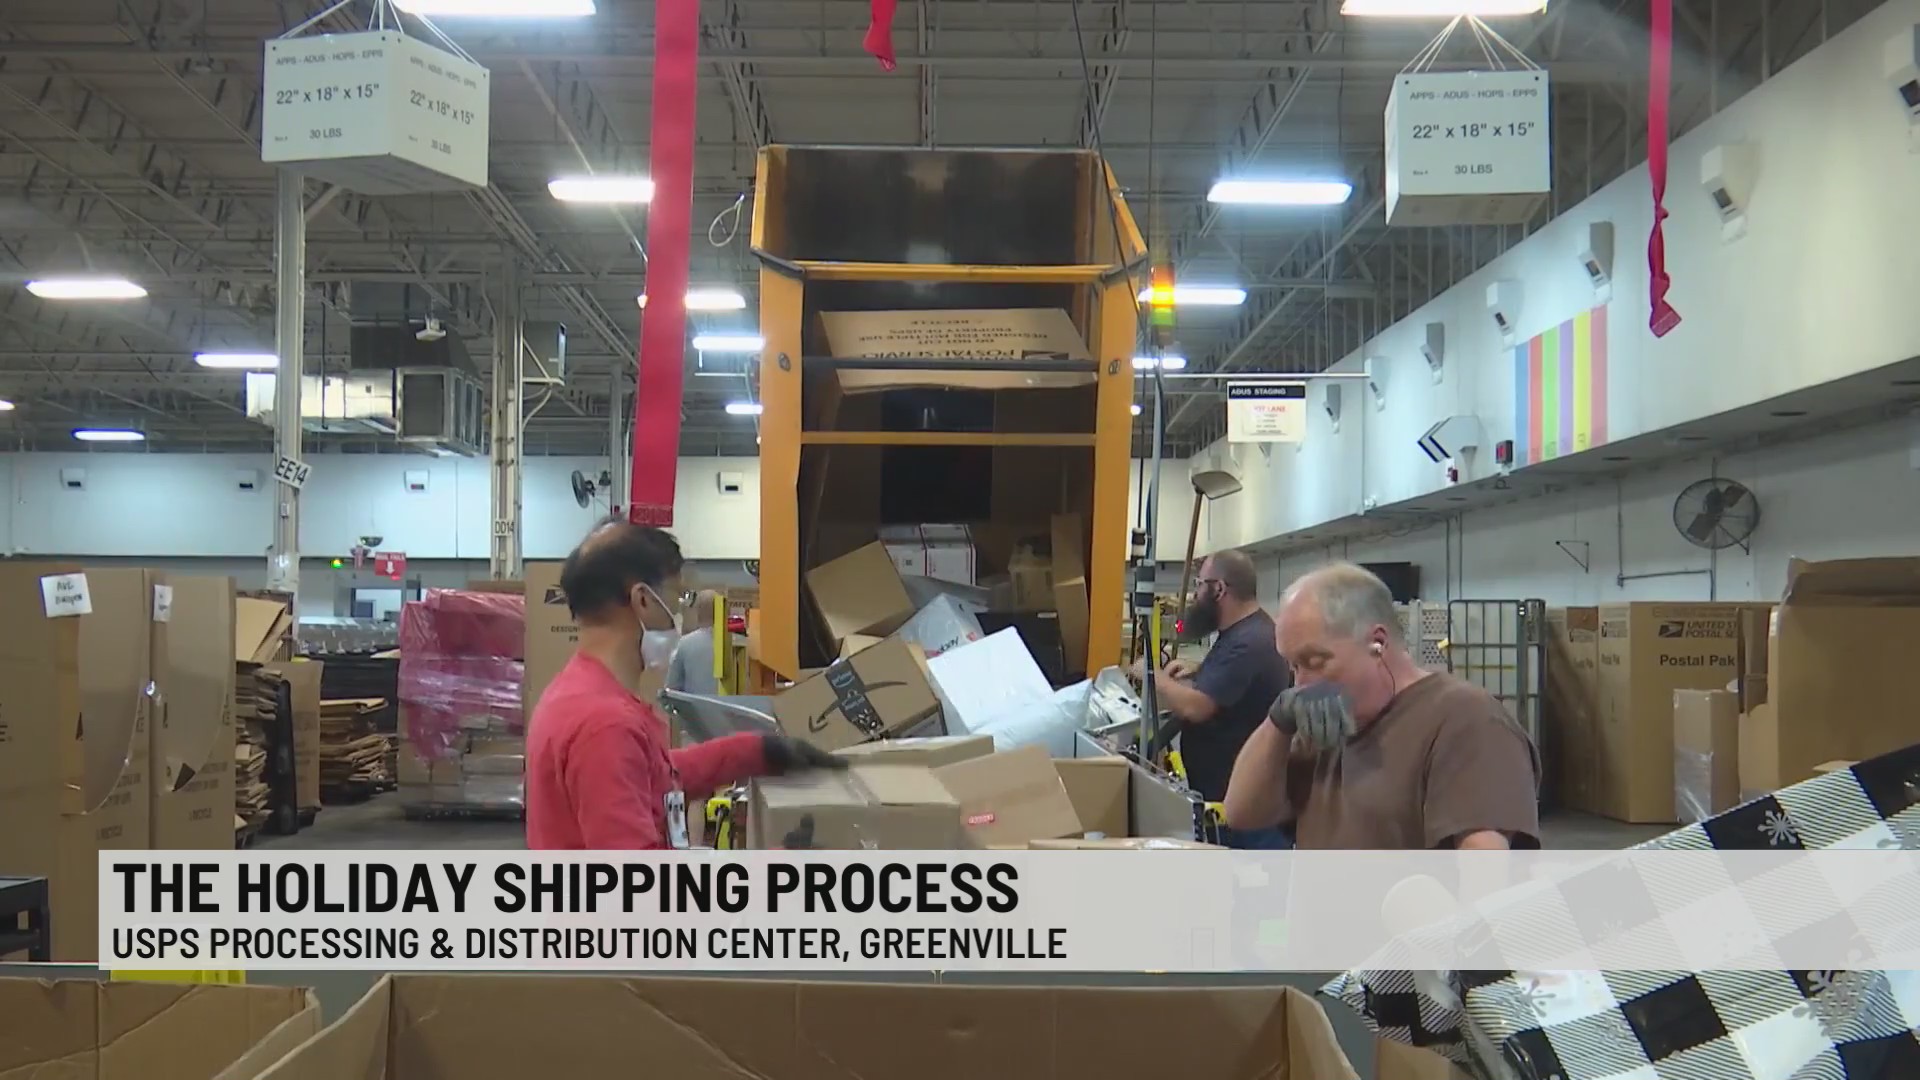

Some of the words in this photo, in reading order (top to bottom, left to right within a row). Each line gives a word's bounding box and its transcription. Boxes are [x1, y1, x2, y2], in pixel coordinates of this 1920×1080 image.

[276, 89, 299, 105] 22"
[303, 91, 311, 102] x
[317, 86, 339, 101] 18"
[343, 88, 351, 99] x
[357, 83, 379, 98] 15"
[1410, 91, 1435, 100] APPS
[1443, 90, 1469, 99] ADUS
[1478, 89, 1504, 98] HOPS
[1512, 88, 1537, 97] EPPS
[410, 89, 426, 107] 22"
[428, 100, 434, 111] x
[436, 100, 450, 116] 18"
[452, 109, 458, 120] x
[461, 110, 474, 125] 15"
[309, 129, 321, 139] 30
[323, 128, 342, 138] LBS
[1413, 124, 1439, 139] 22"
[1445, 127, 1455, 138] x
[1460, 123, 1487, 138] 18"
[1493, 126, 1502, 137] x
[1508, 121, 1534, 138] 15"
[1455, 164, 1468, 174] 30
[1470, 164, 1493, 174] LBS
[945, 349, 1015, 357] POSTAL
[275, 457, 309, 486] EE14
[495, 521, 515, 534] DD14
[1687, 621, 1726, 629] UNITED
[1685, 630, 1720, 638] POSTAL
[1660, 654, 1704, 666] Postal
[1709, 655, 1736, 666] Pak
